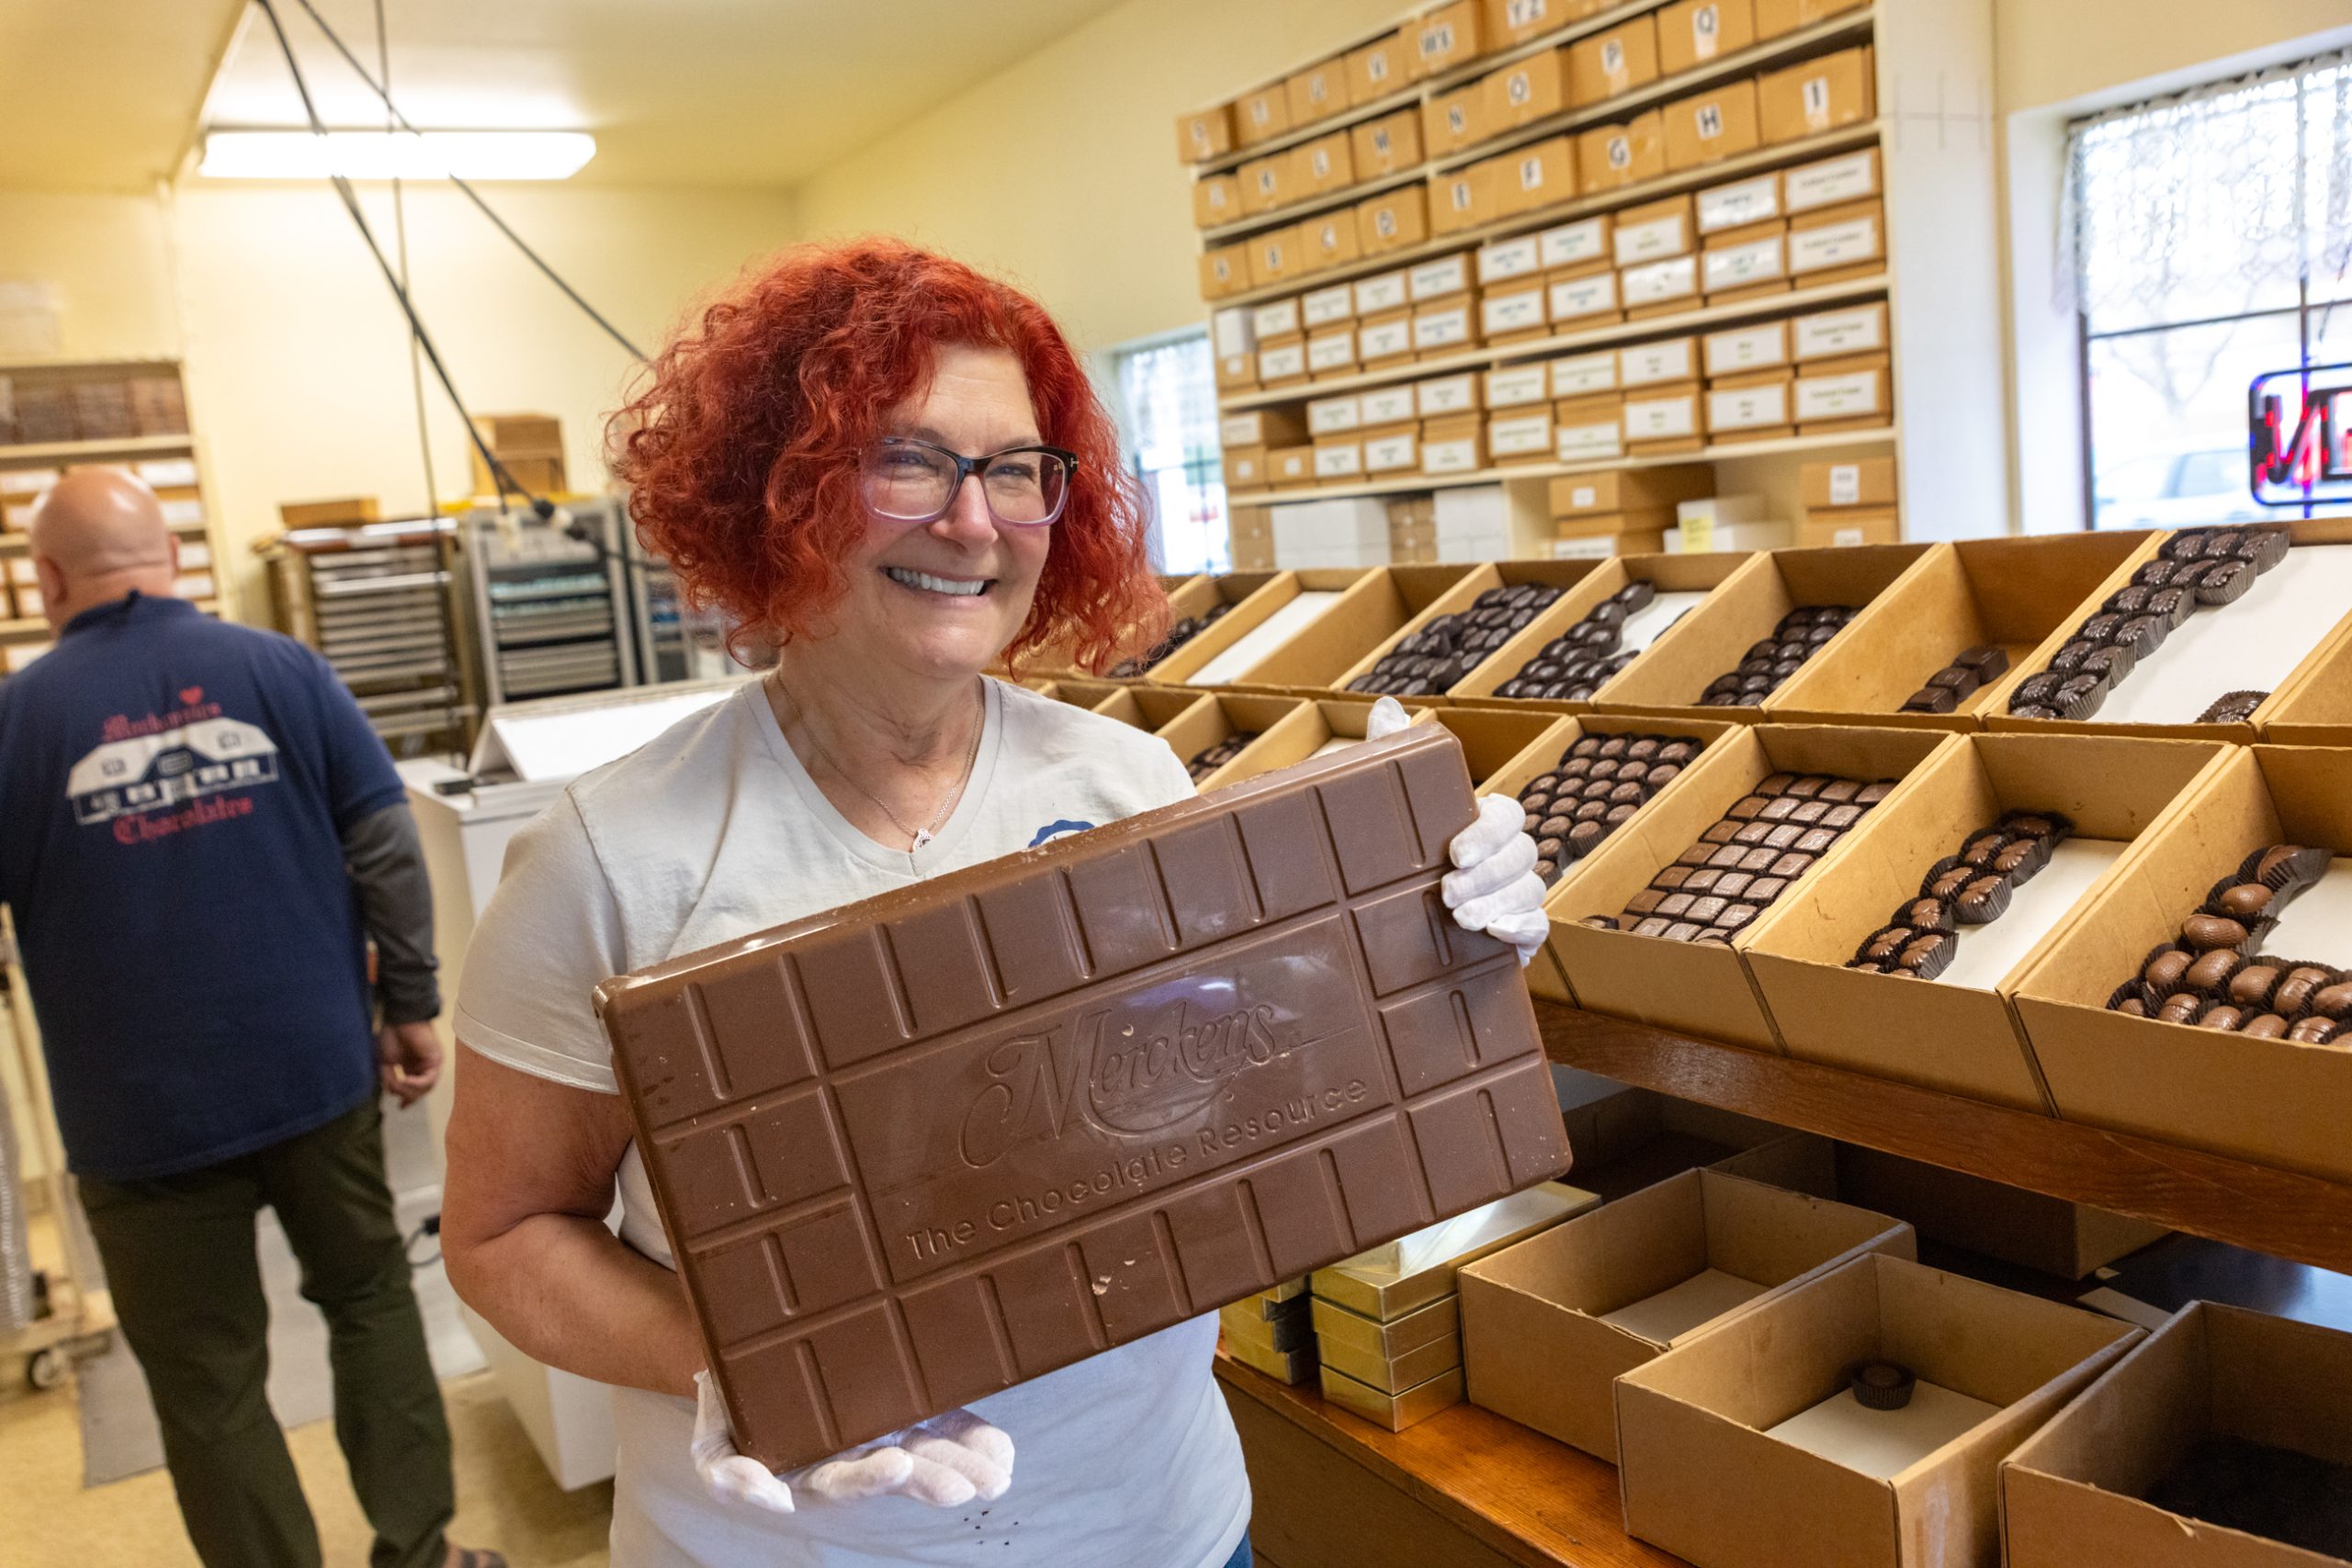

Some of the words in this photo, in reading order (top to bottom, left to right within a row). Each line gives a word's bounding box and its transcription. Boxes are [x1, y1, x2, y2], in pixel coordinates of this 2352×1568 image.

[1698, 8, 1714, 34] Q
[1607, 44, 1620, 67] P
[1700, 107, 1721, 136] H
[1609, 140, 1626, 166] G
[958, 1000, 1278, 1169] Merckens
[905, 1219, 977, 1259] The
[986, 1144, 1188, 1231] Chocolate
[1197, 1077, 1368, 1156] Resource
